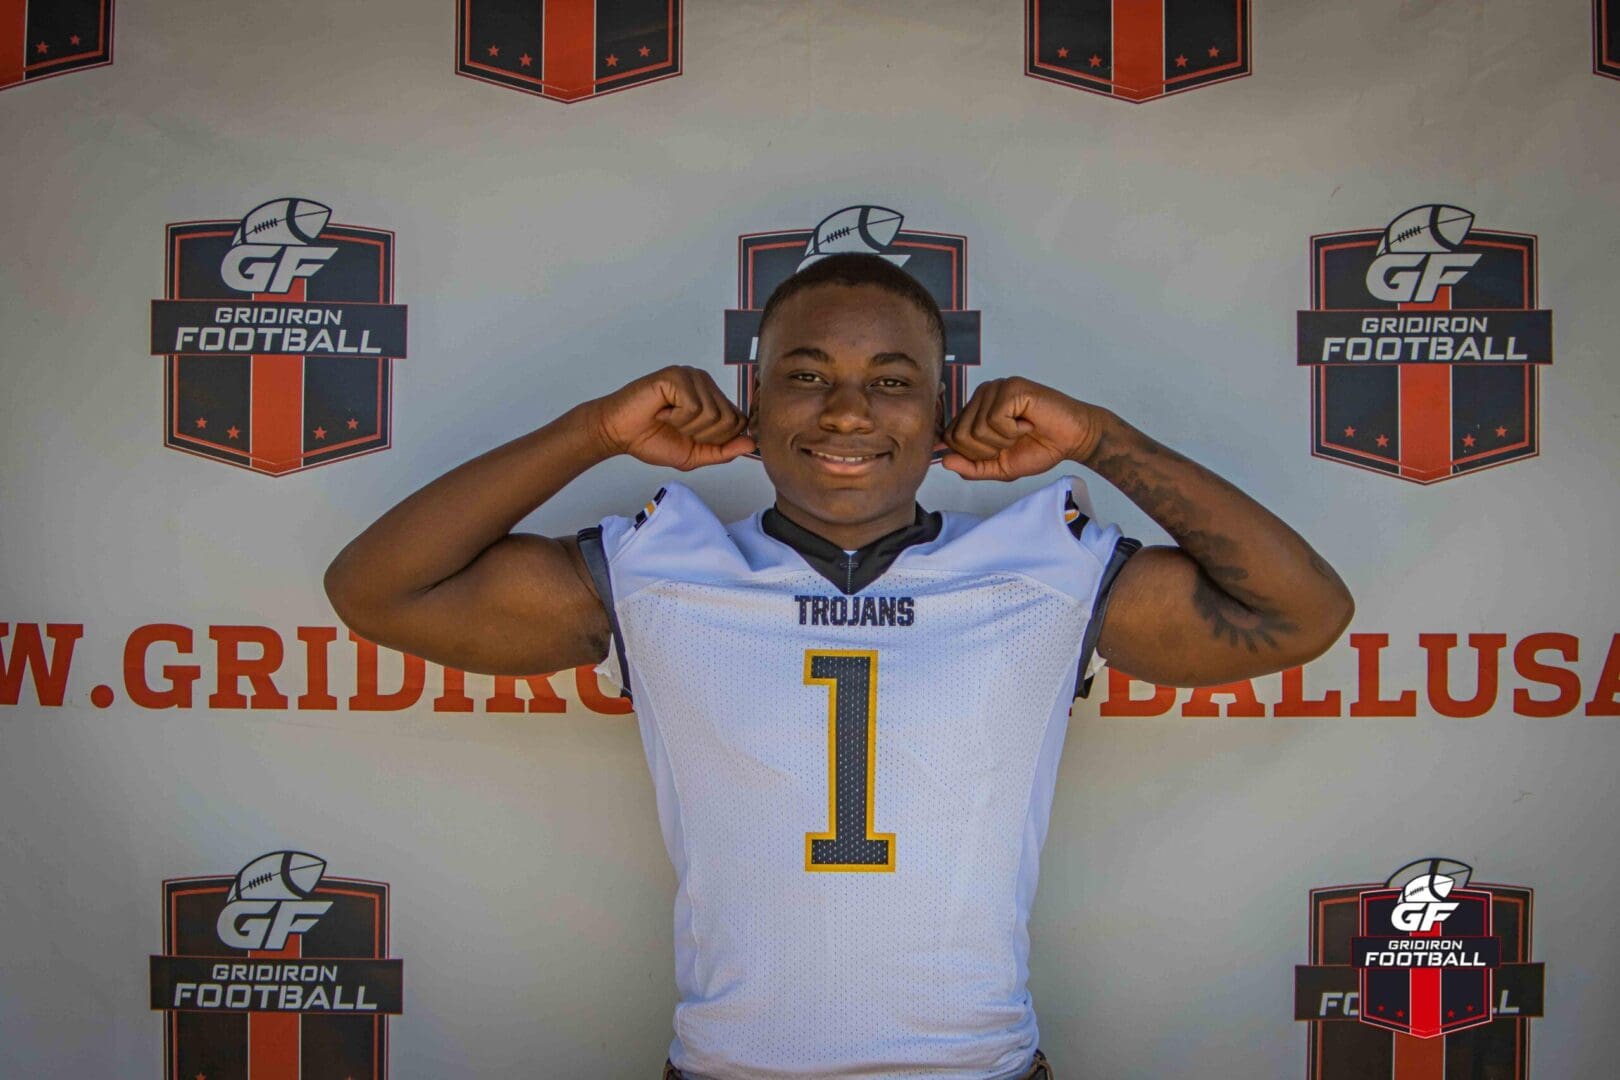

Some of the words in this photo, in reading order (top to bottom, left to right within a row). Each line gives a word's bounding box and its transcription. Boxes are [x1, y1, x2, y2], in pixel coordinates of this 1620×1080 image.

[221, 244, 339, 294] GF
[1366, 252, 1483, 303] GF
[215, 307, 343, 325] GRIDIRON
[1361, 316, 1488, 334] GRIDIRON
[175, 326, 382, 354] FOOTBALL
[1321, 336, 1528, 361] FOOTBALL
[794, 594, 915, 627] TROJANS
[803, 648, 897, 873] 1
[216, 900, 334, 950] GF
[212, 963, 338, 983] GRIDIRON
[173, 983, 378, 1010] FOOTBALL
